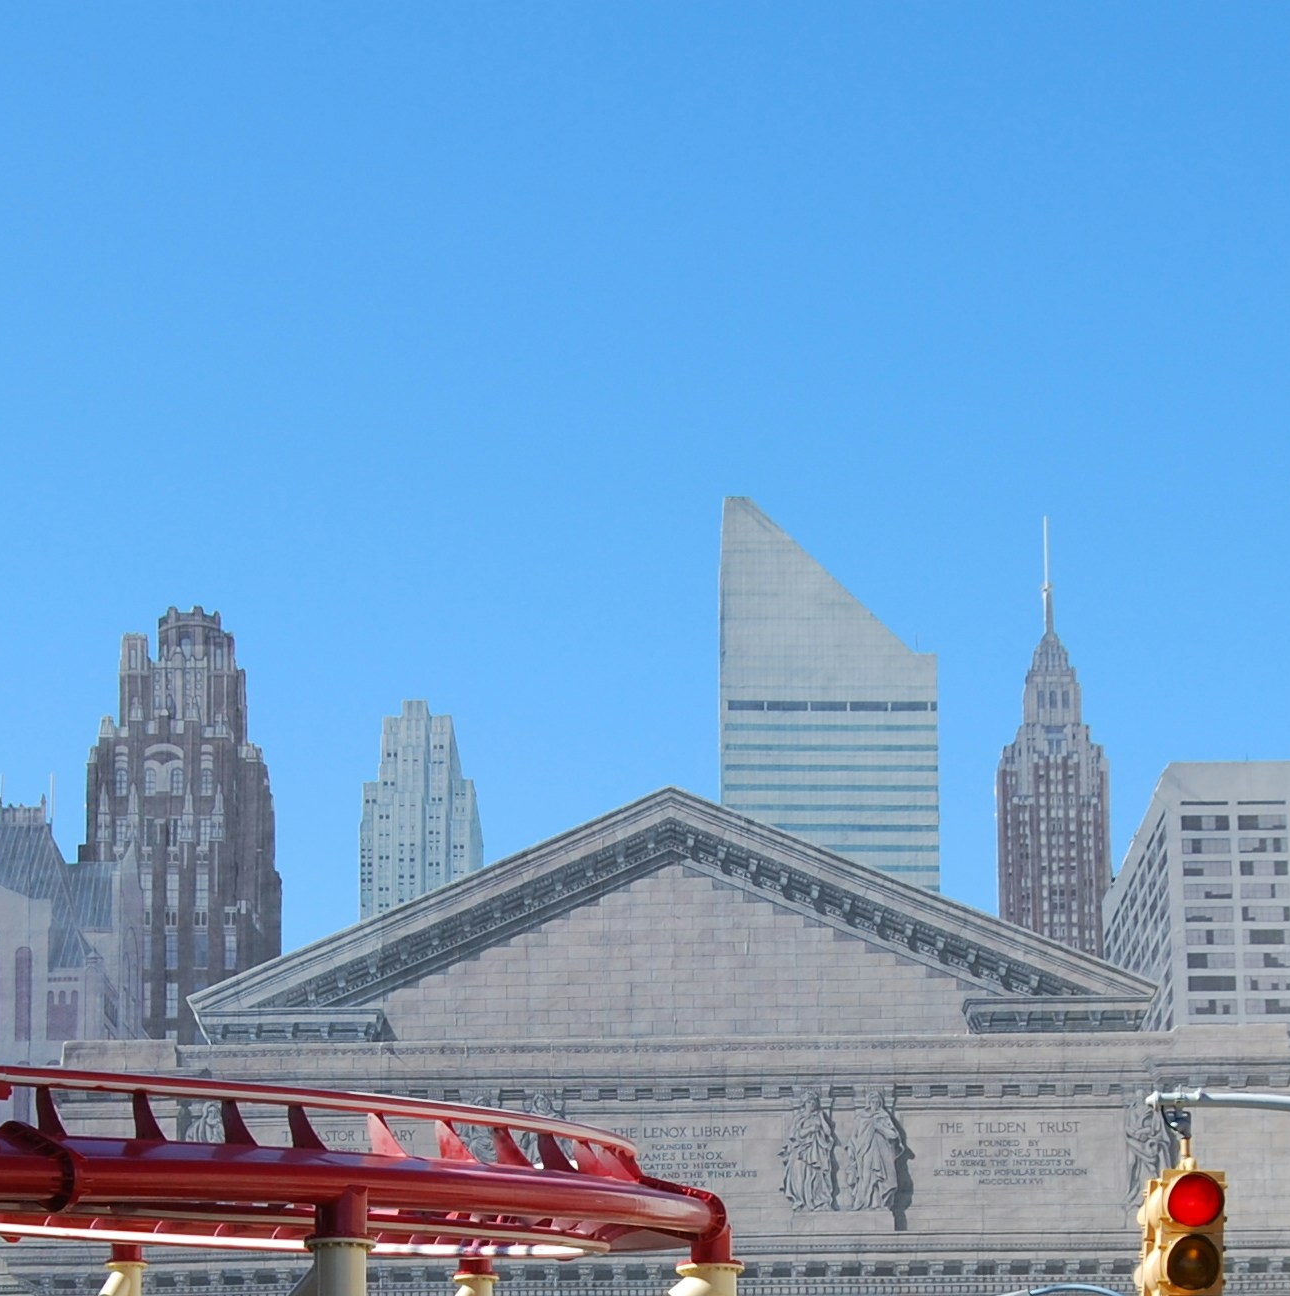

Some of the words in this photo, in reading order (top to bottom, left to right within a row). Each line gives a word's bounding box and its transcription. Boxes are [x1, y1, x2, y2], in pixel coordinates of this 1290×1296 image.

[643, 1126, 688, 1138] LENOX
[693, 1126, 748, 1137] LIBRARY
[938, 1122, 964, 1134] THE
[974, 1122, 1026, 1133] TILDEN
[1037, 1121, 1080, 1133] TRUST
[362, 1130, 416, 1142] LARY
[651, 1143, 693, 1151] FOUNDED
[978, 1139, 1020, 1147] FOUNDED
[1028, 1139, 1040, 1147] BY
[637, 1153, 676, 1161] JAMES
[681, 1151, 724, 1160] LENOX
[950, 1149, 991, 1158] SAMUEL
[995, 1149, 1031, 1158] JONES
[1035, 1148, 1071, 1157] TILDEN
[693, 1161, 738, 1169] HISTORY
[990, 1159, 1008, 1167] THE
[1012, 1159, 1061, 1167] INTERESTS
[933, 1169, 970, 1177] SCIENCE
[994, 1168, 1036, 1176] POPULAR
[1039, 1168, 1088, 1176] EDUCATION
